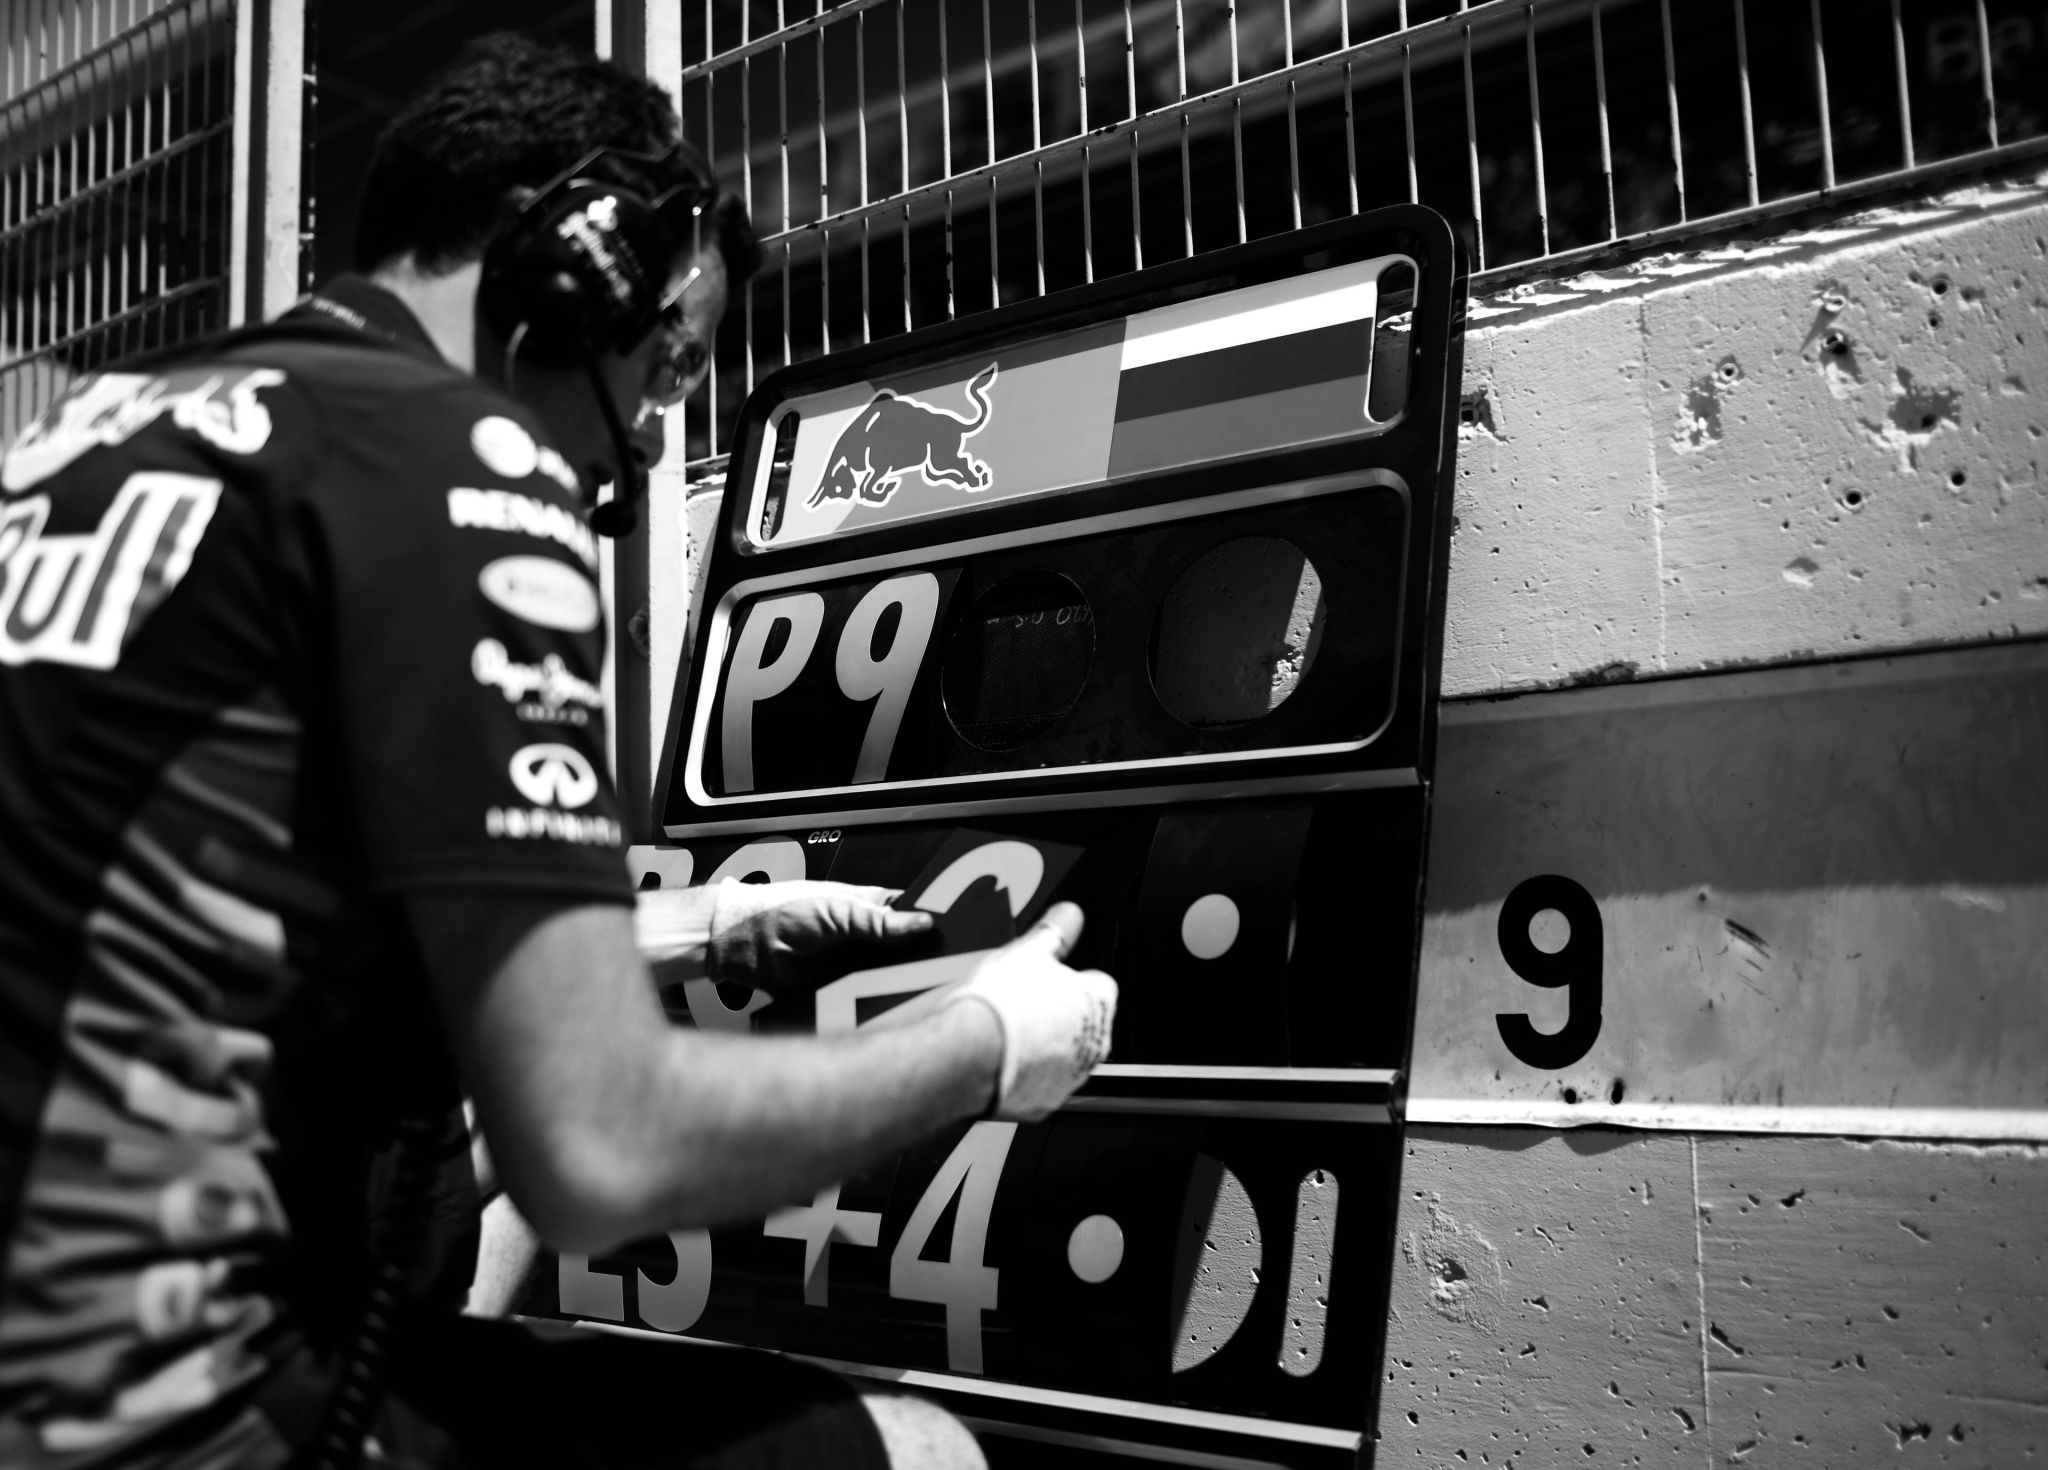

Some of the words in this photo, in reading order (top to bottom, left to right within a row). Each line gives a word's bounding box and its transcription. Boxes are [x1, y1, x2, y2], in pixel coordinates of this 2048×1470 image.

[721, 571, 940, 793] P9
[807, 829, 842, 844] GRO
[1496, 874, 1604, 1070] 9
